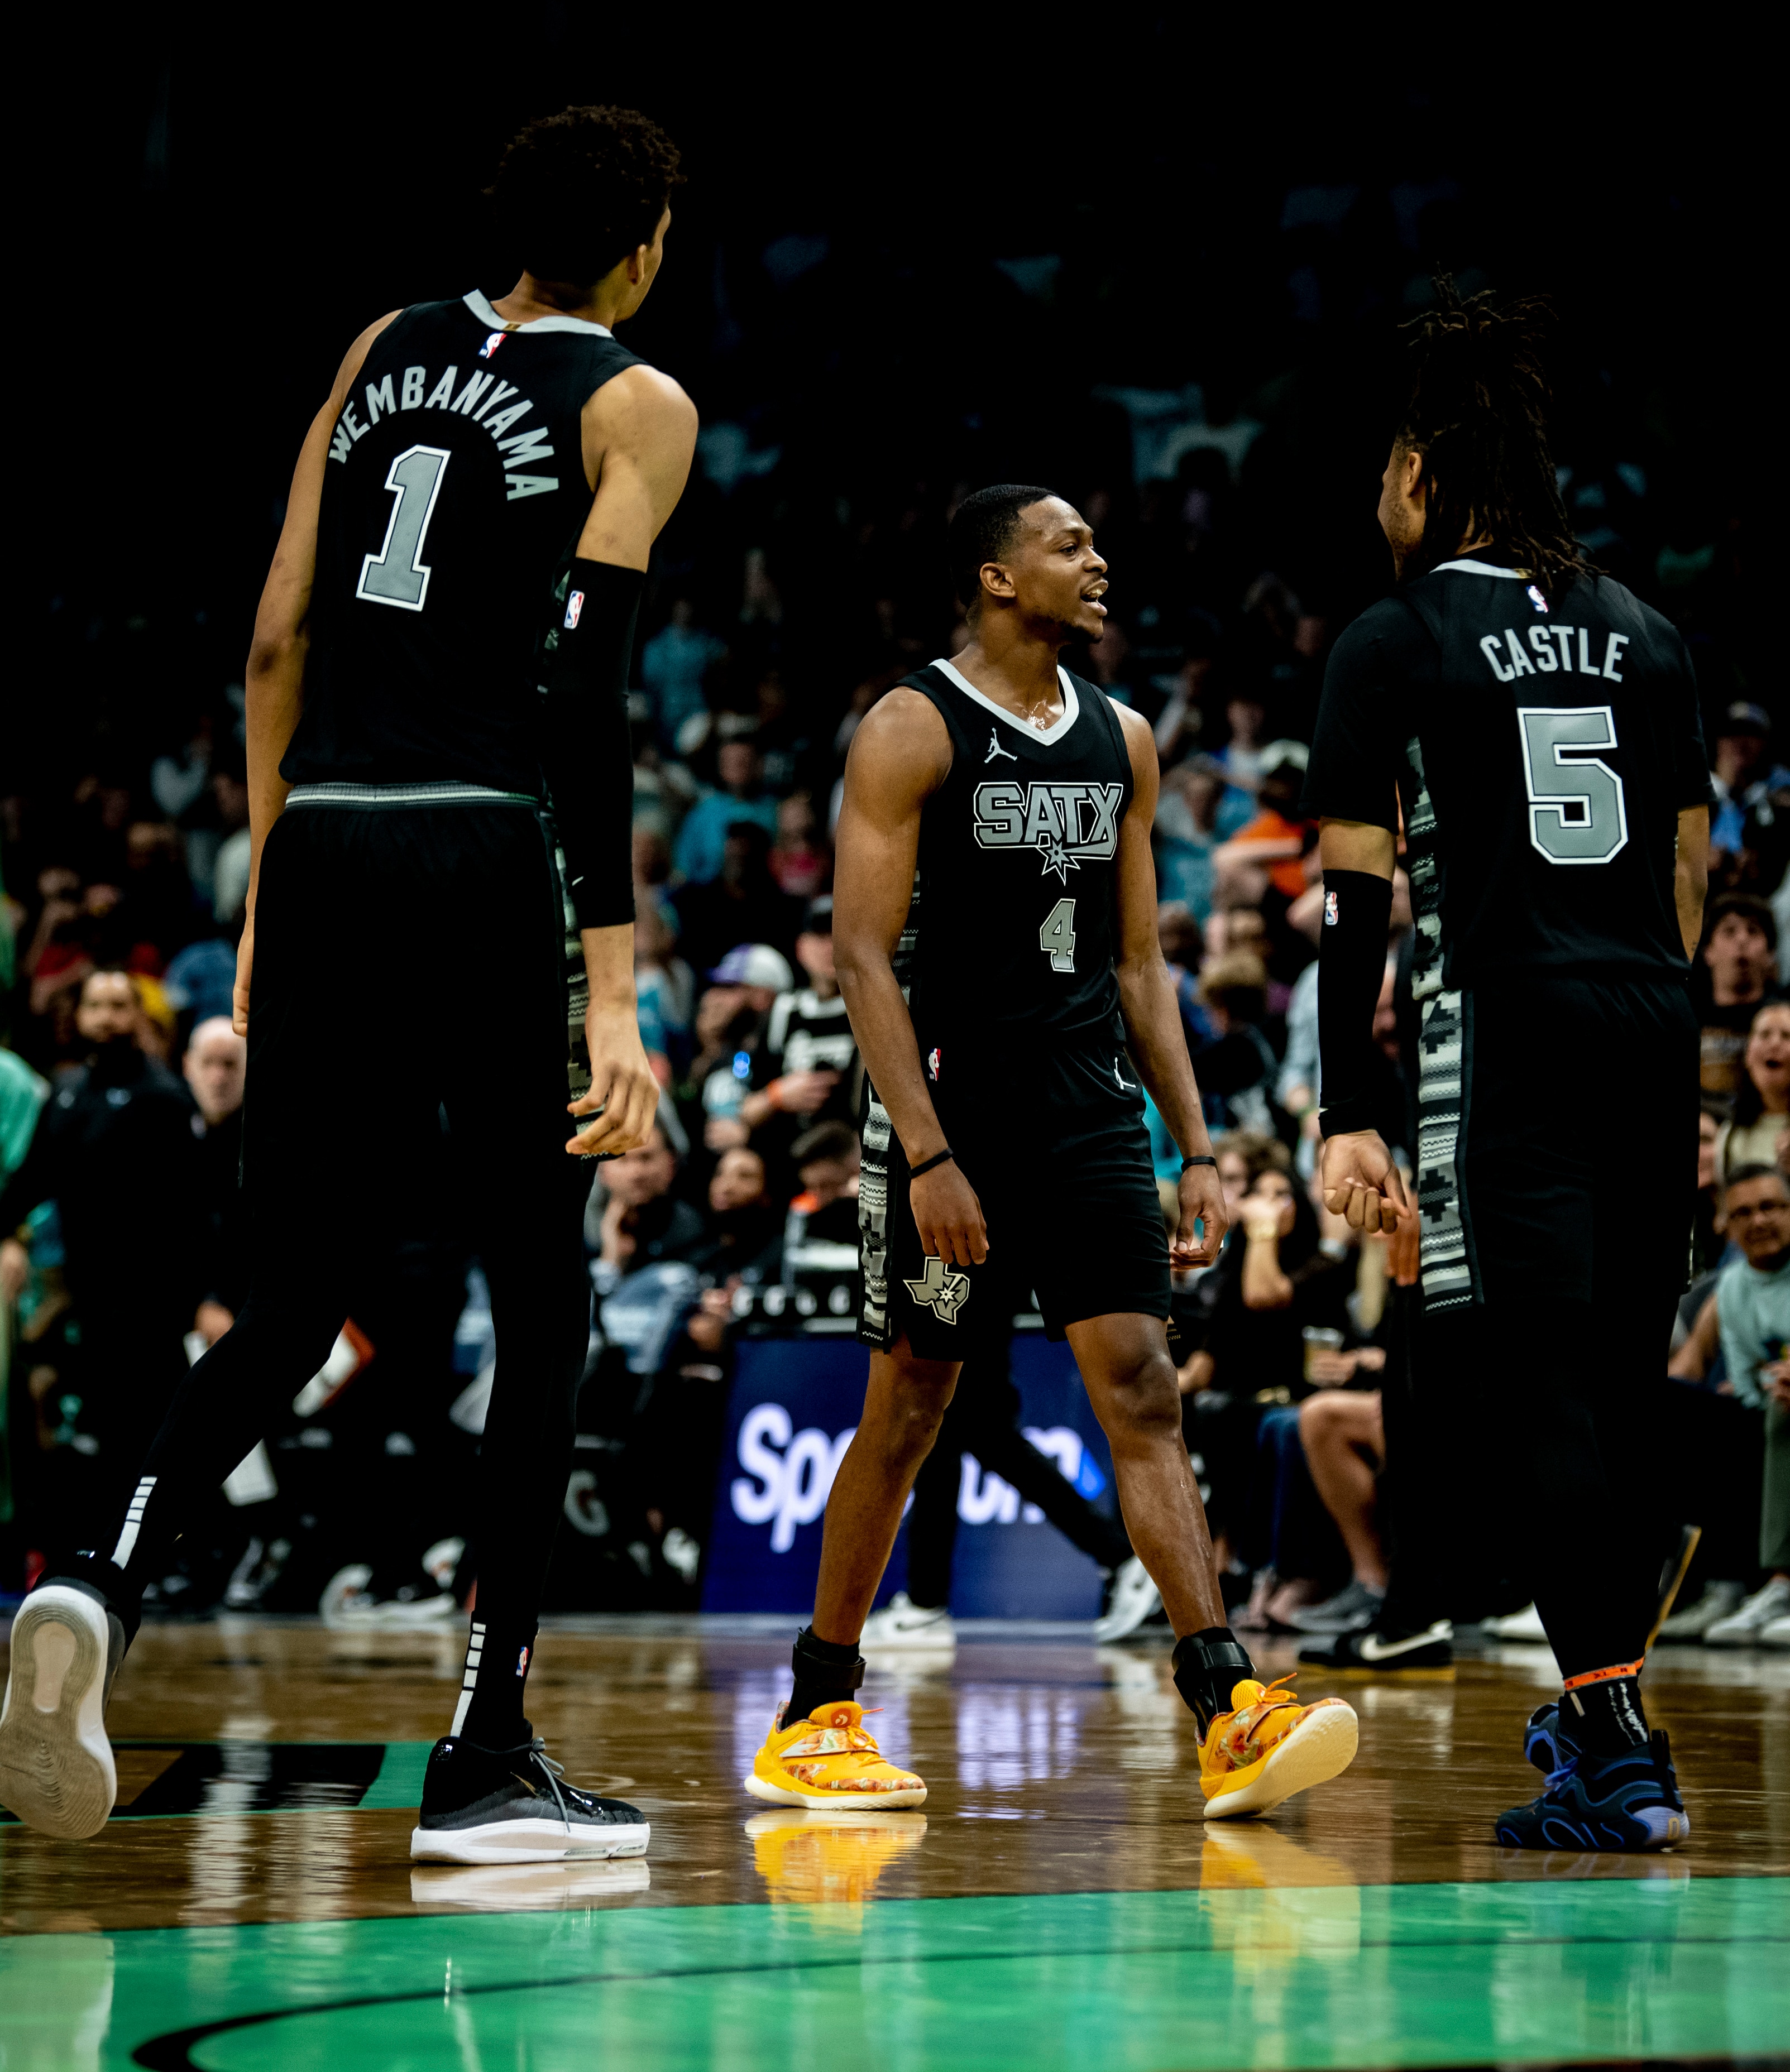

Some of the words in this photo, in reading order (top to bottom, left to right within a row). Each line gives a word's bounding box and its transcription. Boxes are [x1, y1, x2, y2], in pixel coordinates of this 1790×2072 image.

[329, 366, 559, 501] WEMBANYAMA
[357, 445, 451, 611] 1
[1481, 626, 1629, 683] CASTLE
[975, 783, 1122, 860] SATX
[1518, 707, 1628, 864] 5
[1040, 899, 1075, 972] 4
